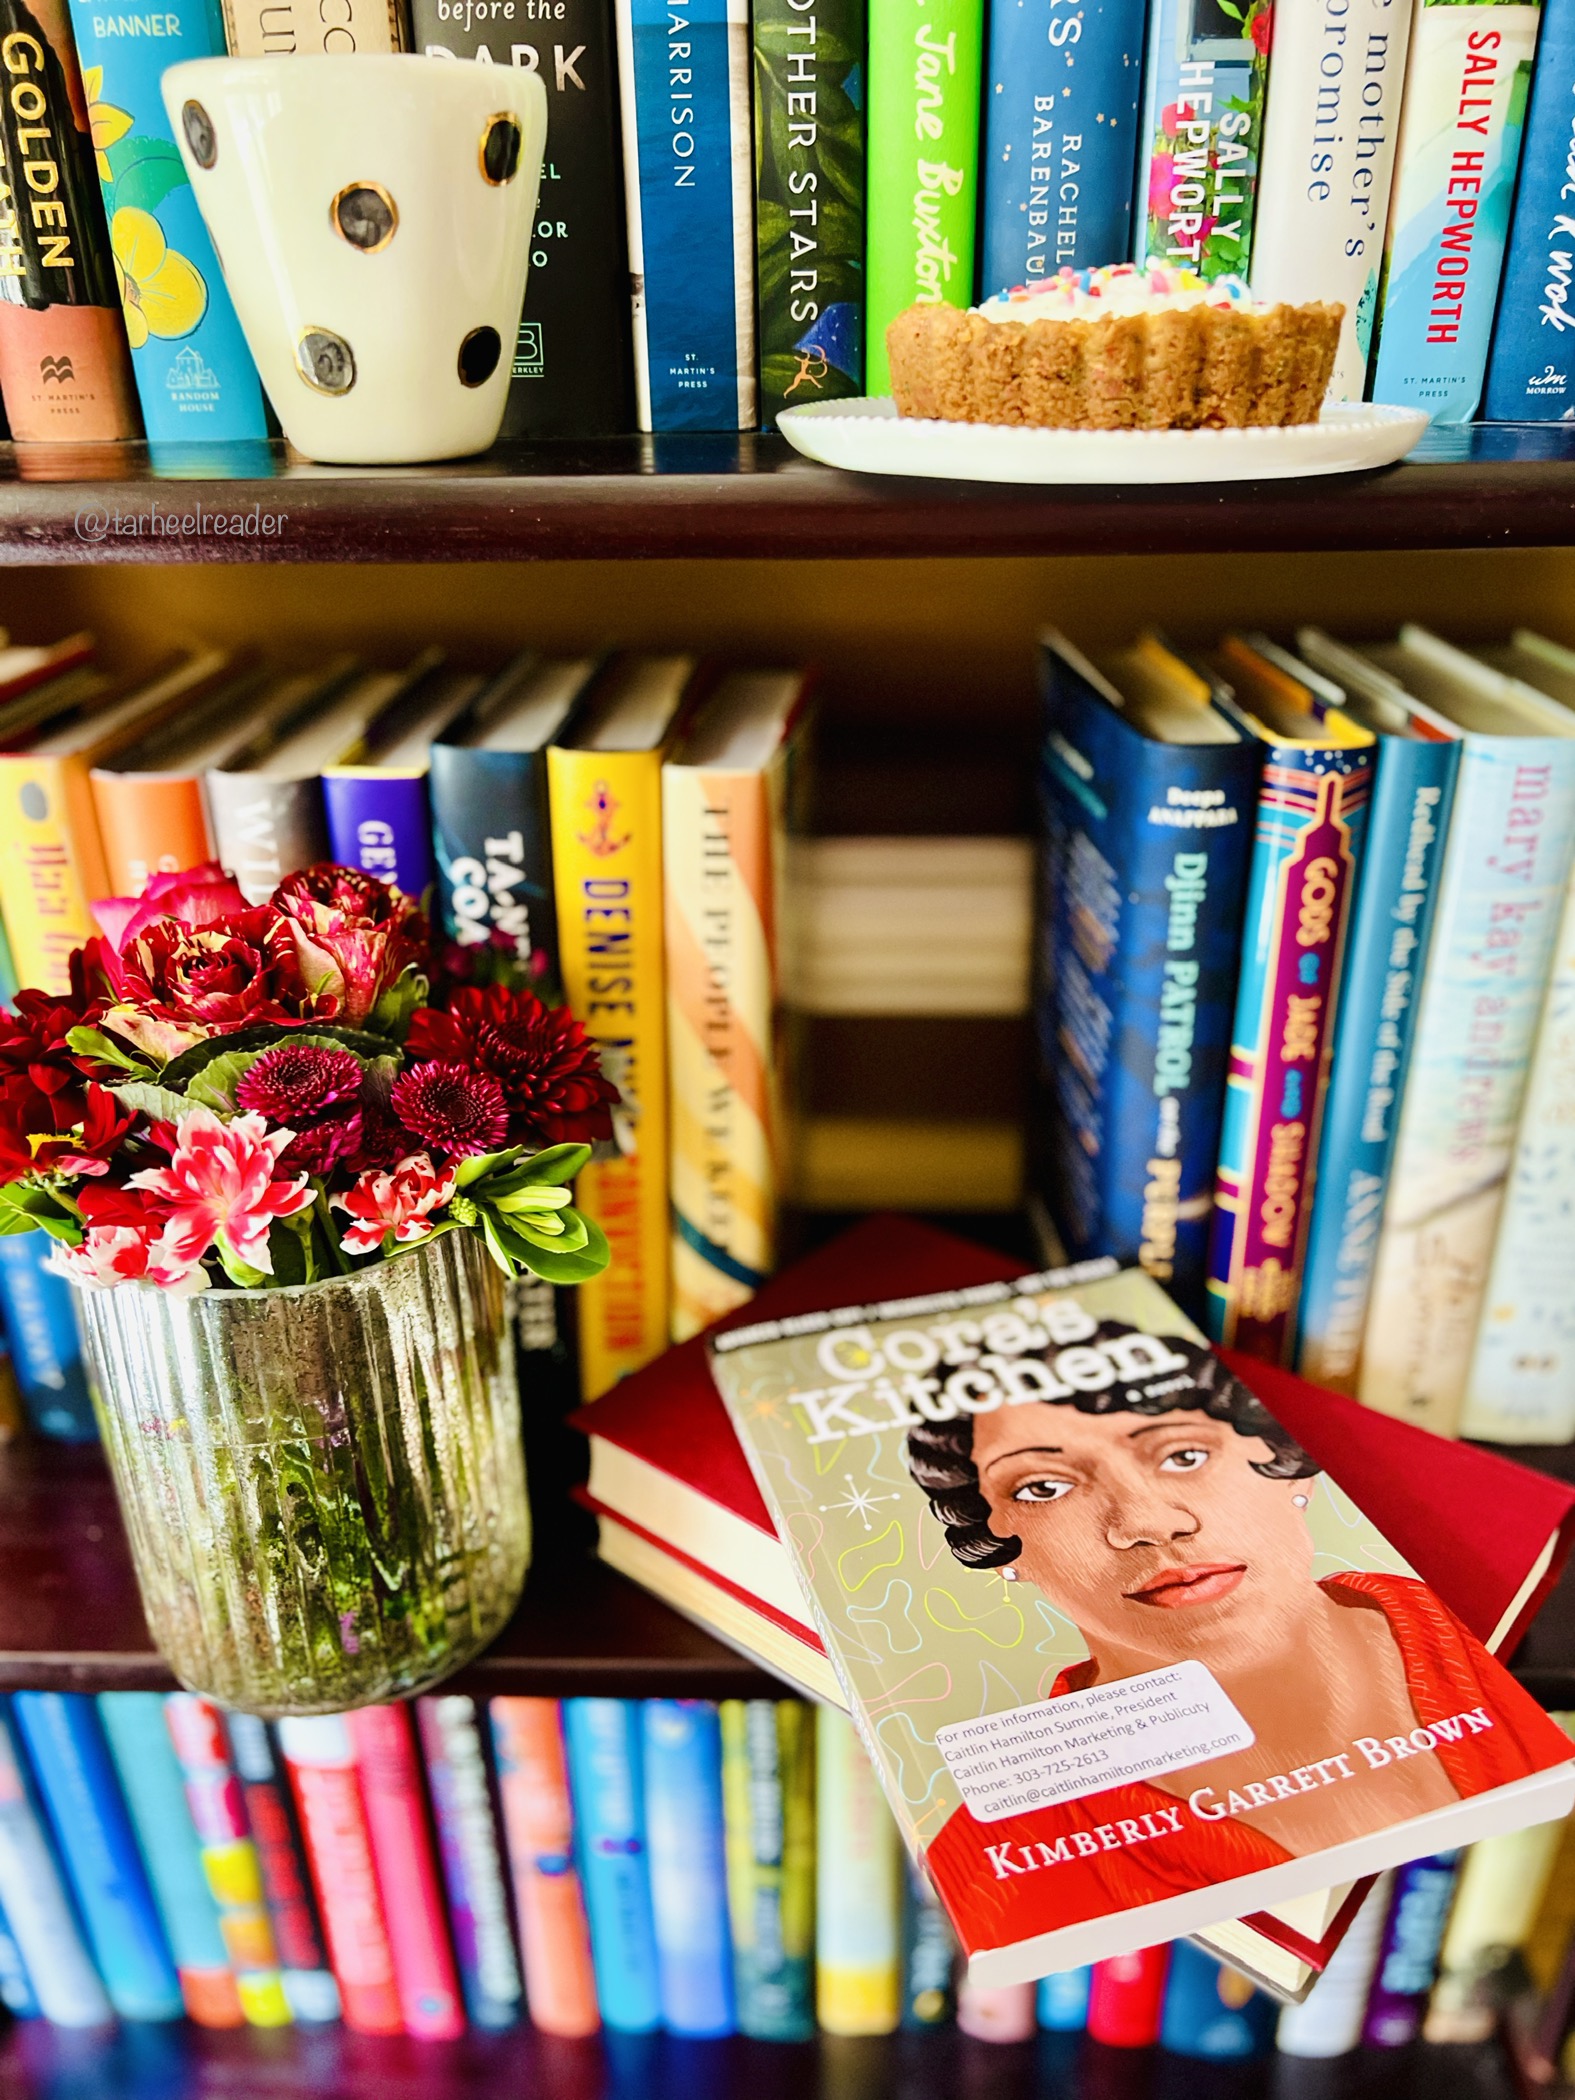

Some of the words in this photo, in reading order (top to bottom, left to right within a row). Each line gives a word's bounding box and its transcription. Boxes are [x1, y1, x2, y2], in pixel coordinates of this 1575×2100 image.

[93, 13, 182, 38] BANNER
[437, 0, 515, 32] before
[526, 0, 566, 20] the
[425, 44, 588, 91] RK
[914, 24, 957, 141] Jane
[1456, 30, 1502, 135] SALLY
[3, 32, 74, 267] GOLDEN
[1166, 60, 1216, 274] HEPWORT
[1210, 112, 1252, 242] SALLY
[1056, 133, 1083, 264] RACHEL
[788, 172, 818, 322] STARS
[1426, 151, 1485, 343] HEPWORTH
[171, 392, 220, 401] RANDOM
[669, 367, 715, 376] MARTIN'S
[678, 380, 708, 389] PRESS
[684, 353, 699, 362] ST.
[1403, 376, 1418, 385] ST.
[1421, 375, 1467, 385] MARTIN'S
[1418, 389, 1449, 398] PRESS
[1526, 385, 1567, 395] MORROW
[49, 393, 96, 402] MARTIN'S
[50, 407, 80, 415] PRESS
[179, 403, 215, 412] HOUSE
[1486, 764, 1552, 882] mary
[1165, 852, 1208, 951] Djinn
[1295, 856, 1339, 947] GODS
[583, 879, 636, 1018] DENISE
[1153, 959, 1199, 1098] PATROL
[817, 1298, 1098, 1383] Cora's
[788, 1330, 1190, 1444] Kitchen
[935, 1731, 958, 1746] For
[961, 1721, 999, 1738] more
[1000, 1697, 1085, 1728] information,
[1086, 1685, 1128, 1714] please
[1129, 1671, 1183, 1694] contact:
[944, 1742, 987, 1763] Caitlin
[989, 1725, 1054, 1751] Hamilton
[1055, 1708, 1115, 1734] Summie,
[1114, 1690, 1178, 1714] President
[952, 1760, 997, 1781] Caitlin
[999, 1742, 1062, 1768] Hamilton
[1064, 1721, 1136, 1750] Marketing
[1136, 1717, 1147, 1731] &
[961, 1776, 1012, 1798] Phone:
[1013, 1748, 1110, 1785] 303-725-2613
[983, 1731, 1241, 1814] caitlin@caitlinhamiltonmarketing.com
[984, 1806, 1186, 1879] KIMBERLY
[1187, 1751, 1355, 1822] GARRETT
[1352, 1706, 1495, 1770] BROWN
